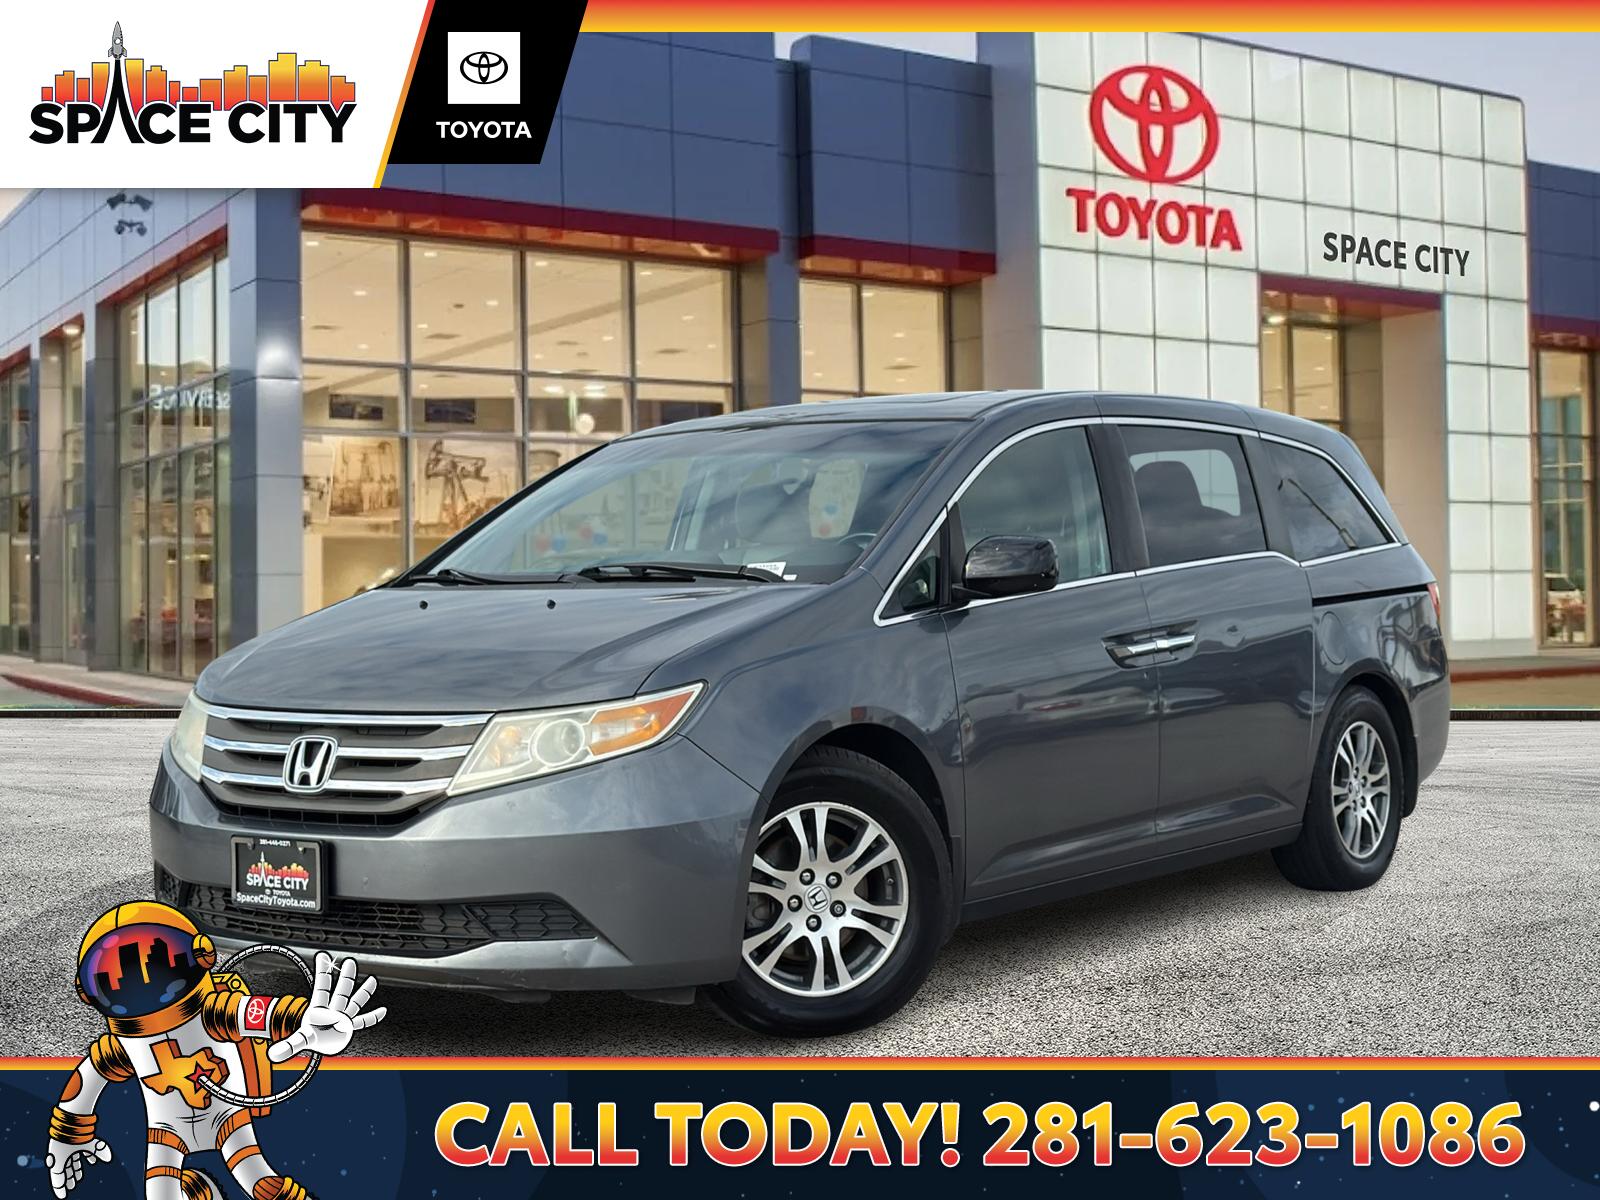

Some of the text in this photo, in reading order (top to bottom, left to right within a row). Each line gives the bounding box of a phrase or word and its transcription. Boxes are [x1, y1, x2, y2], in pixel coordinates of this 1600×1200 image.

[1066, 187, 1243, 251] TOYOTA
[1322, 231, 1471, 277] SPACE CITY
[246, 872, 309, 891] SPACE CITY
[236, 892, 316, 909] SpaceCityToyota.com
